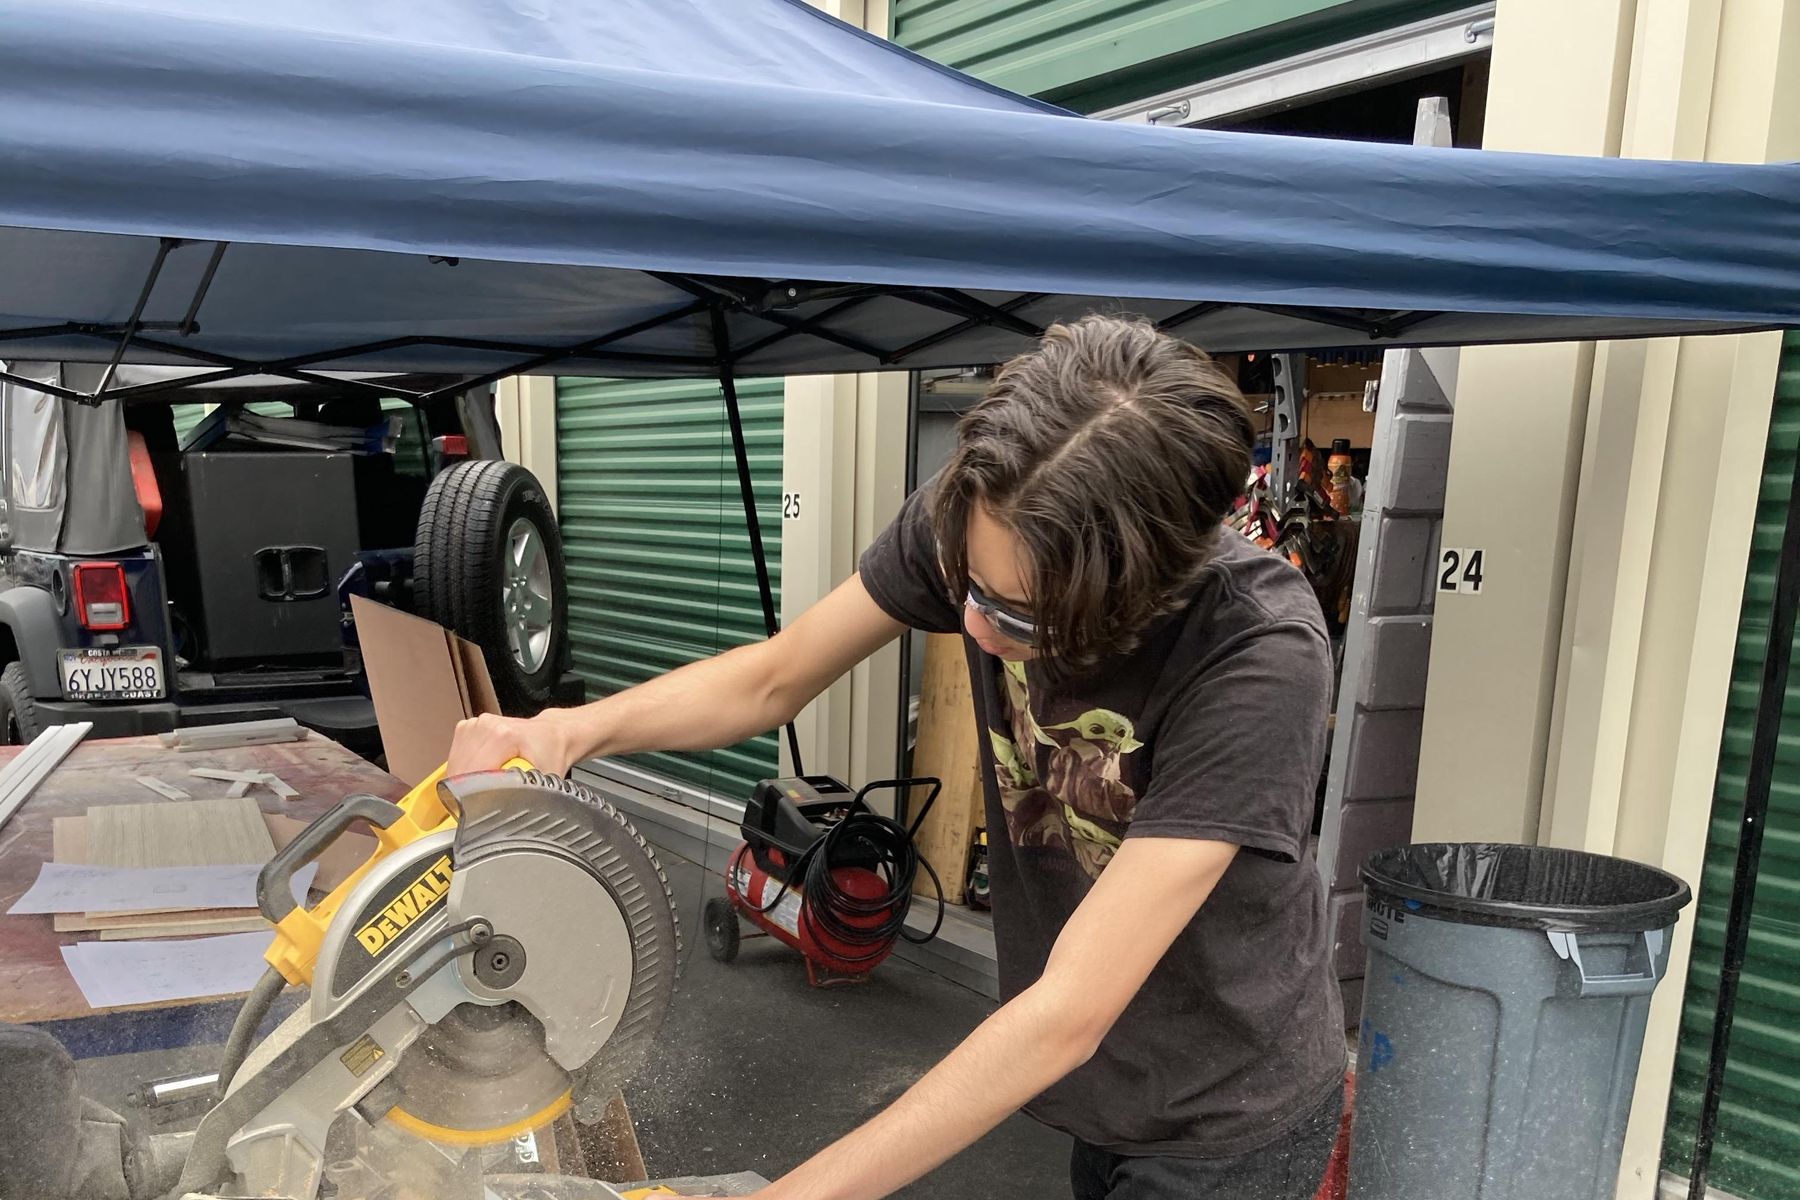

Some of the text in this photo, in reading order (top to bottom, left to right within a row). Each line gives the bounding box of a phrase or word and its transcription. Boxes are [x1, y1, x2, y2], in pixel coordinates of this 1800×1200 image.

[784, 493, 800, 518] 25
[1440, 550, 1483, 591] 24
[69, 666, 157, 692] 6YJY588
[356, 856, 454, 955] DEWALT
